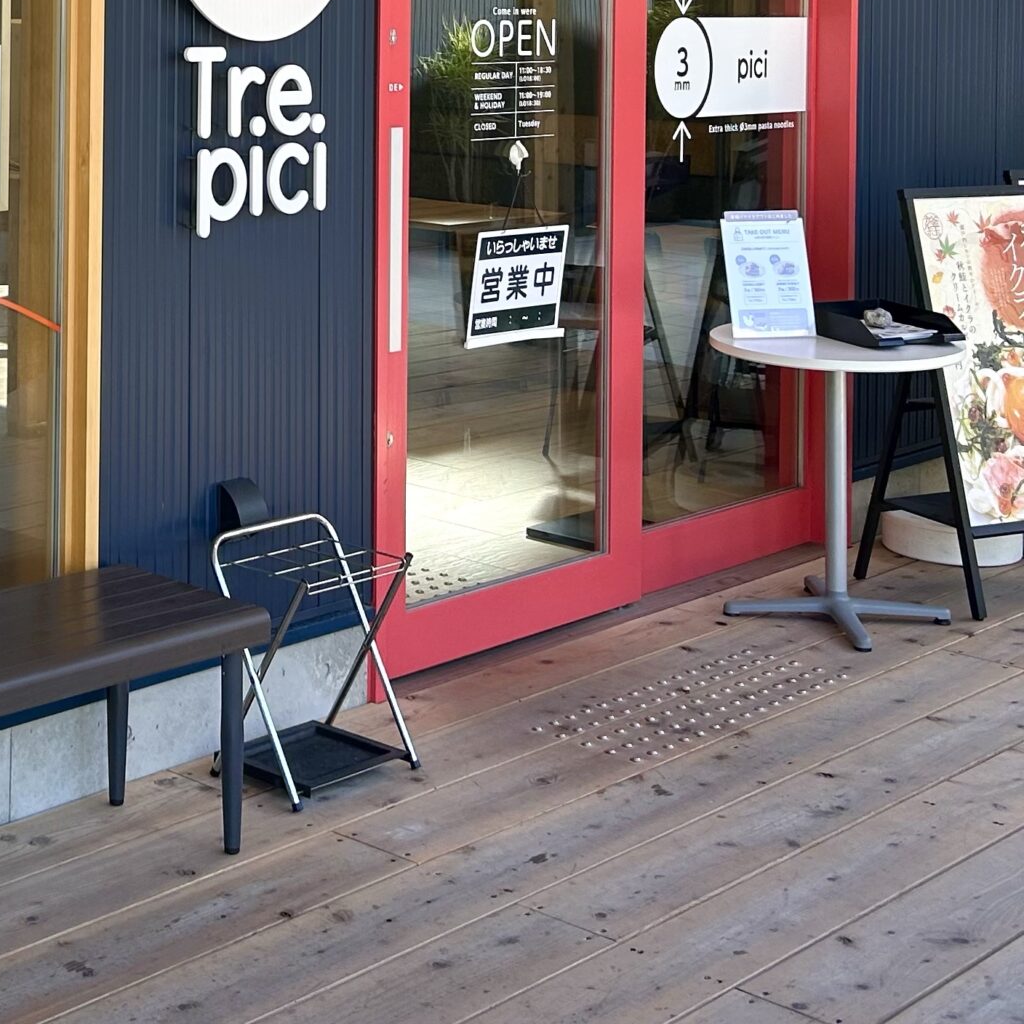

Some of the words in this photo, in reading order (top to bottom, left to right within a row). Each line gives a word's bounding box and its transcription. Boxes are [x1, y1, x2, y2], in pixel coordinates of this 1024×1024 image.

[492, 7, 512, 16] Come
[513, 7, 520, 15] in
[471, 18, 556, 58] OPEN
[676, 46, 689, 77] 3
[737, 49, 768, 84] pici
[474, 72, 500, 80] REGULAR
[501, 71, 513, 79] DAY
[674, 80, 691, 91] mm
[474, 92, 503, 101] WEEKEND
[474, 102, 479, 110] &
[480, 101, 505, 109] HOLIDAY
[474, 123, 497, 131] CLOSED
[518, 120, 541, 128] Tuesday
[708, 124, 723, 133] Extra
[724, 123, 738, 132] thick
[758, 122, 773, 132] pasta
[773, 120, 794, 129] noodles
[486, 235, 558, 256] いらっしゃいませ
[480, 261, 555, 304] 営業中
